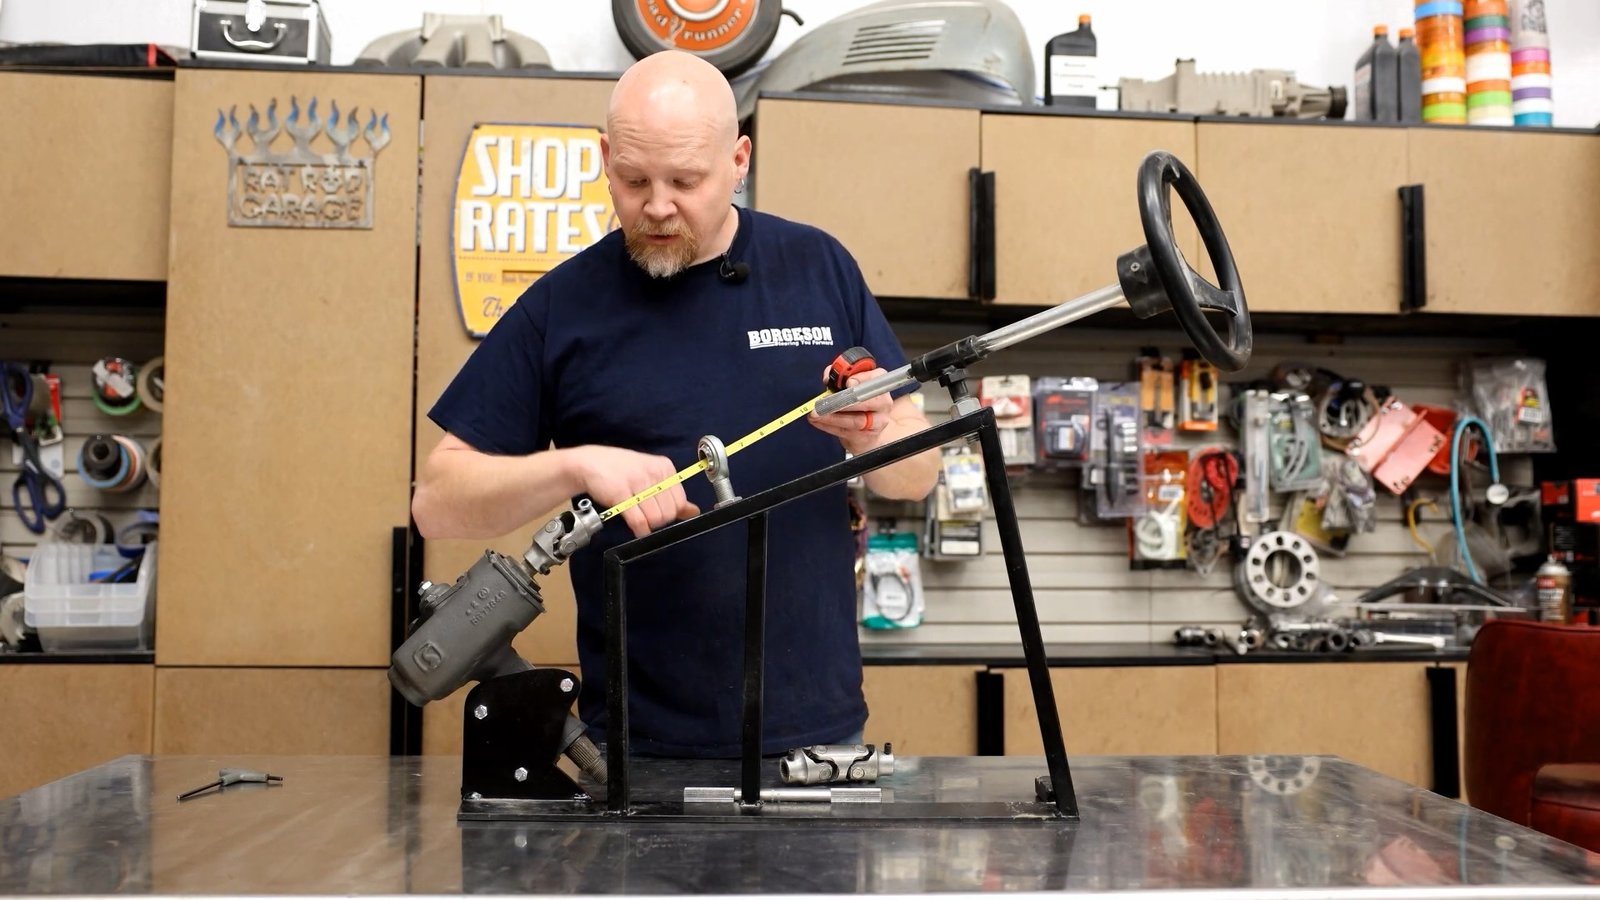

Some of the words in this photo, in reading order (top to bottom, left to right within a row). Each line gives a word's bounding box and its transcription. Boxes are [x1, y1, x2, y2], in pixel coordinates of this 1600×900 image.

[243, 167, 295, 193] RAT
[471, 135, 601, 199] SHOP
[240, 193, 363, 220] GARAGE
[460, 201, 606, 252] RATES
[747, 327, 832, 345] BORGESON
